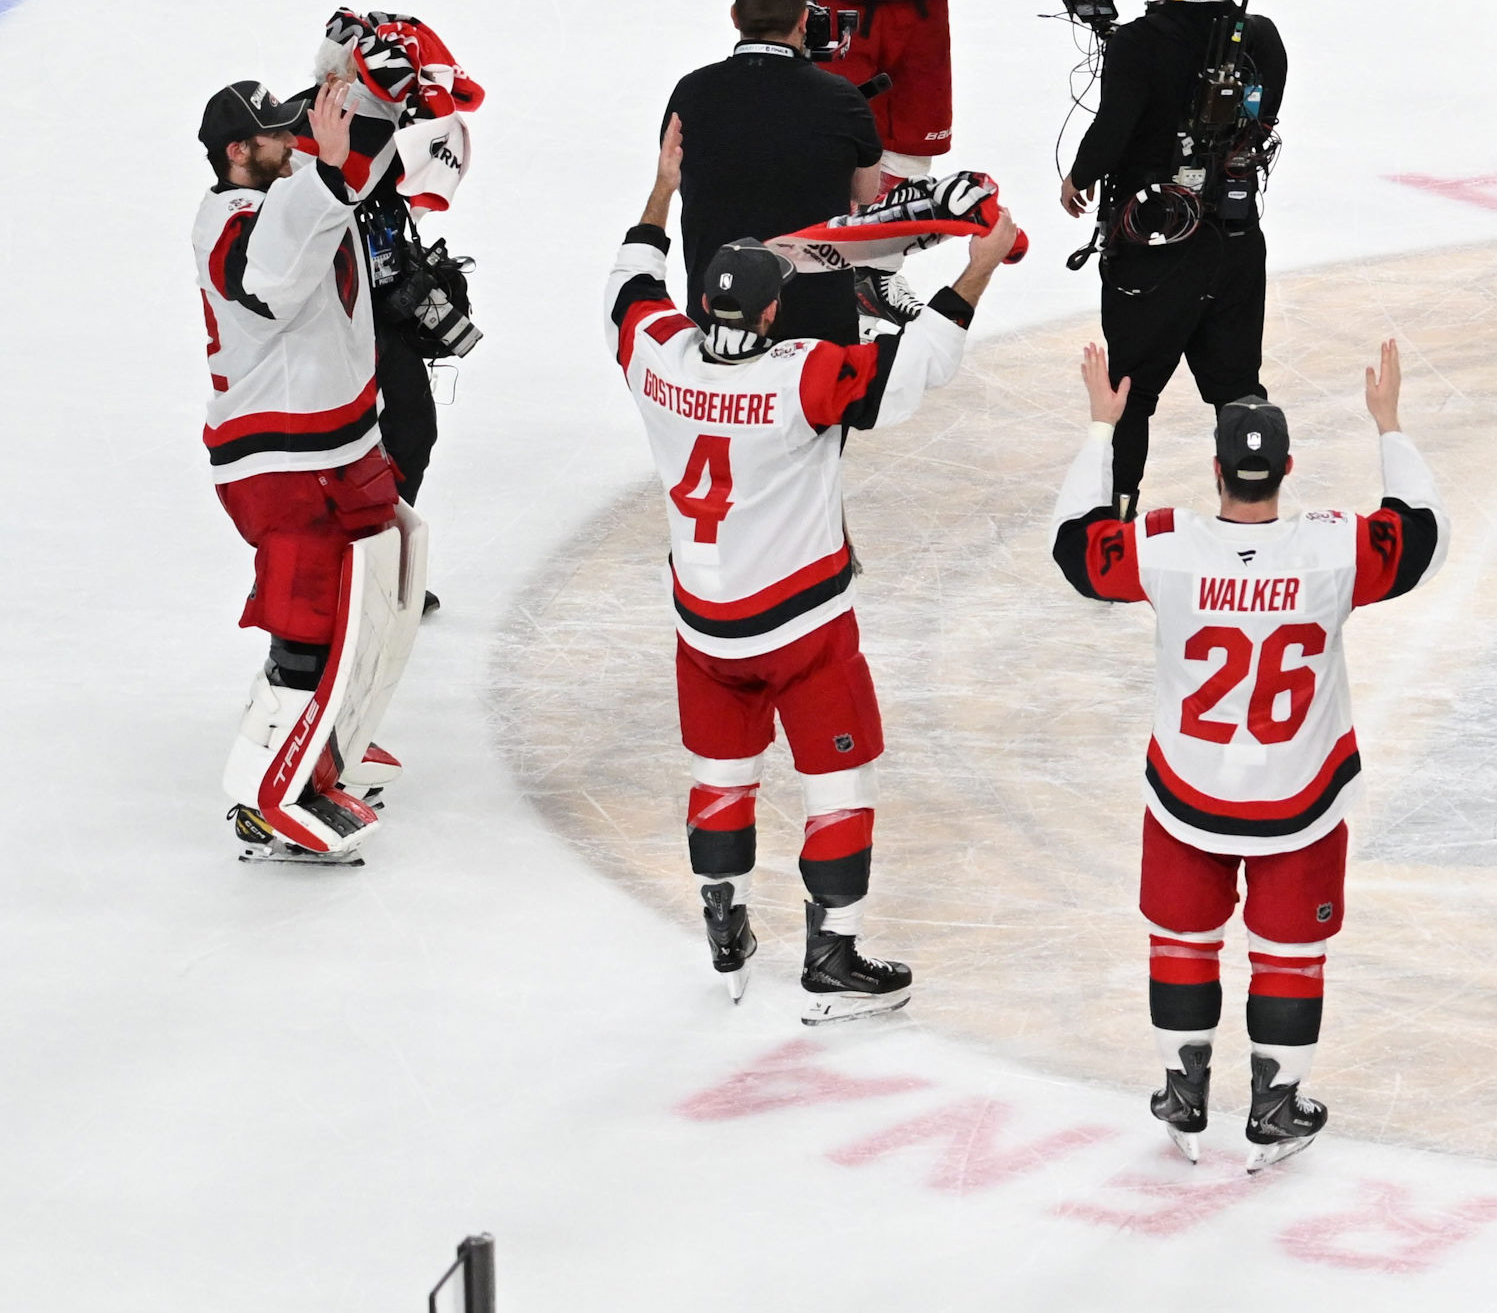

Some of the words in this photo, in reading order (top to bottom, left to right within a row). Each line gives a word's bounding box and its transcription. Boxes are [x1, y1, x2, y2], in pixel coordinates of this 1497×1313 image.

[924, 128, 952, 141] BAU
[643, 368, 777, 425] GOSTISBEHERE
[669, 433, 735, 544] 4
[1198, 577, 1301, 613] WALKER
[1179, 622, 1327, 744] 26
